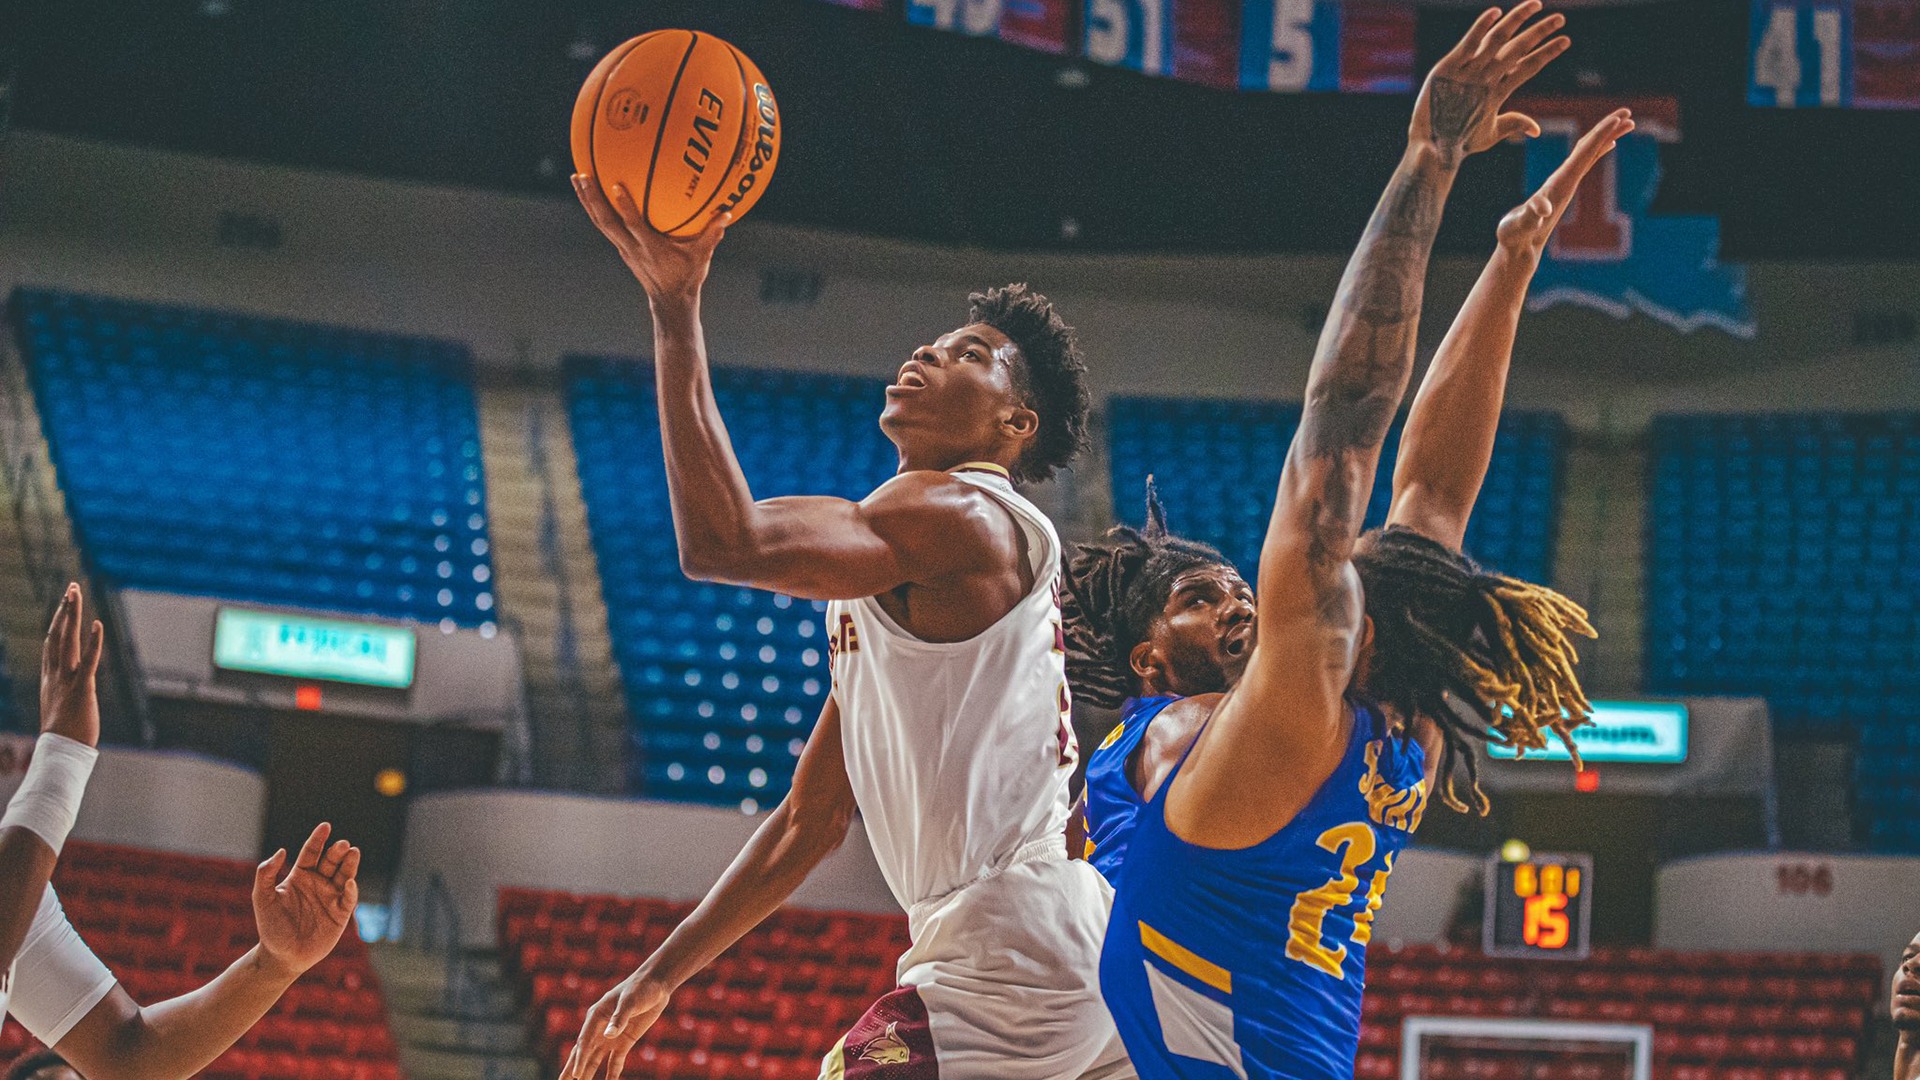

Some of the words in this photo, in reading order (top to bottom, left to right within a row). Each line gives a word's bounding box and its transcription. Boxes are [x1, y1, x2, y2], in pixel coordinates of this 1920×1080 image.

[1755, 8, 1842, 108] 41
[683, 87, 724, 174] EVO
[1523, 893, 1569, 949] 15
